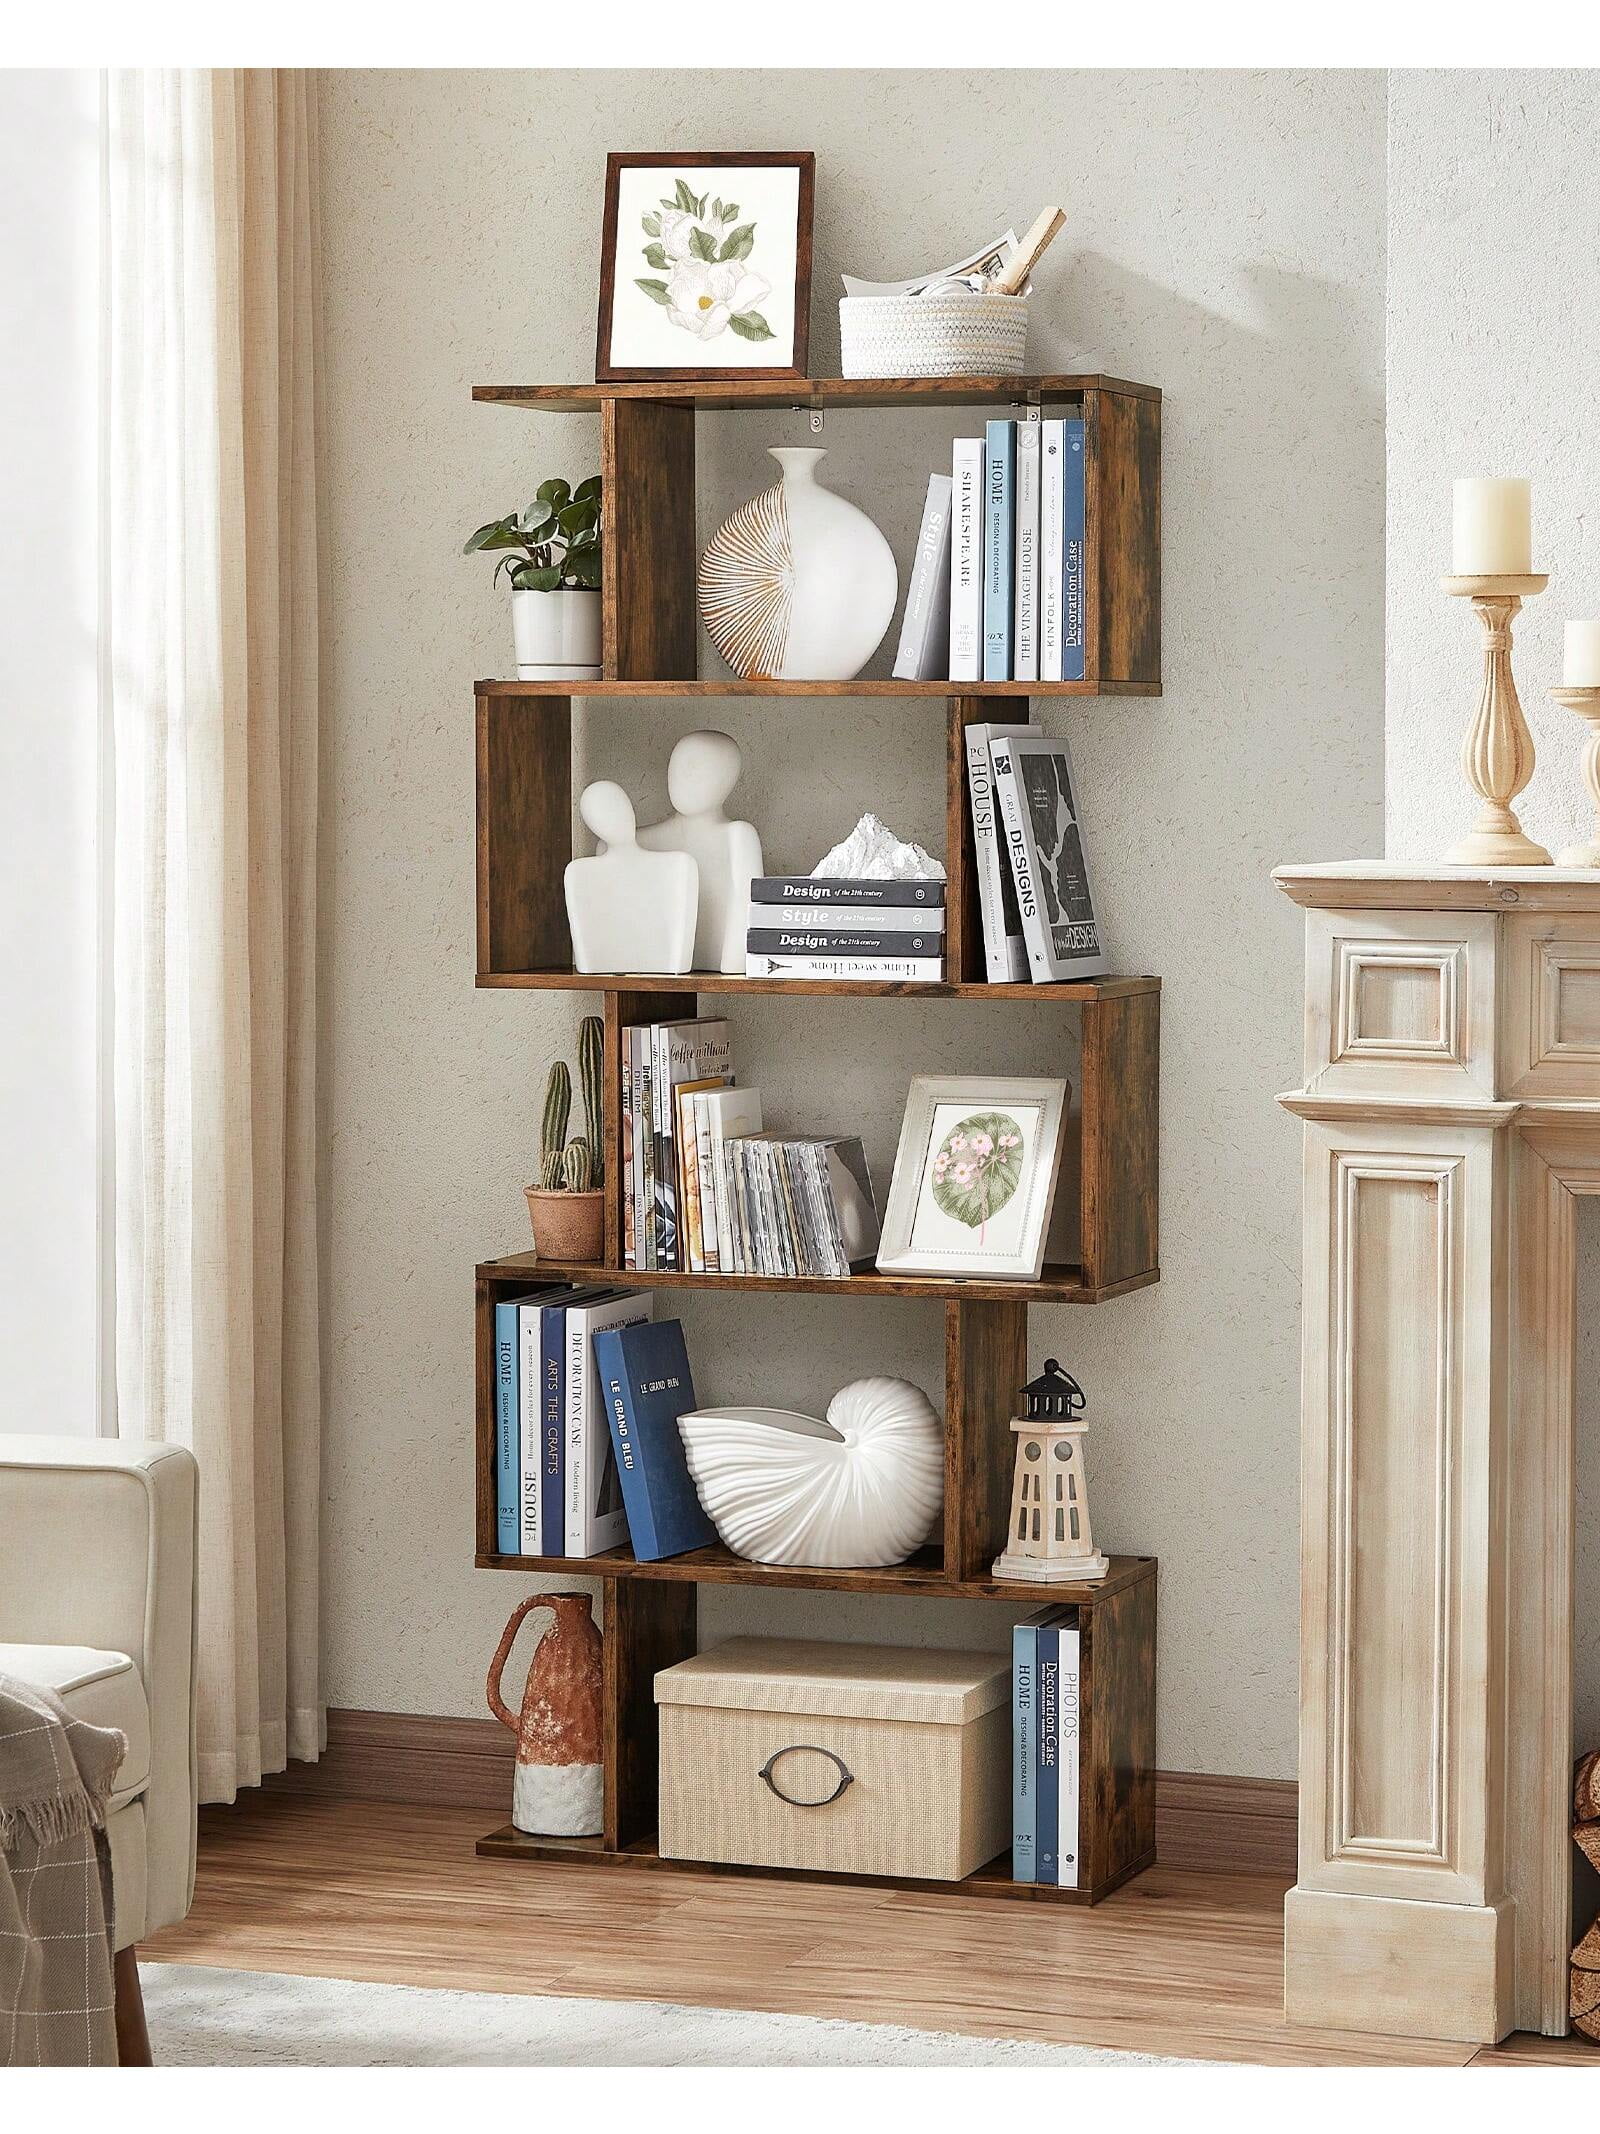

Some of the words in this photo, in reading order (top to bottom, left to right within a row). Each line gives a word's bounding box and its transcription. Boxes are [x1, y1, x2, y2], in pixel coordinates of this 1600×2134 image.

[991, 460, 1004, 505] HOME
[923, 511, 943, 561] Style
[961, 471, 972, 588] SHAKESPEARE
[1022, 528, 1032, 573] HOUSE
[1066, 540, 1078, 572] Case
[992, 548, 1000, 594] DECORATING
[1021, 575, 1031, 631] VINTAGE
[1047, 592, 1055, 647] KINFOLK
[1066, 575, 1078, 648] Decoration
[1021, 634, 1031, 661] THE
[970, 746, 985, 758] PC
[971, 763, 993, 839] HOUSE
[1006, 793, 1017, 823] GREAT
[1010, 830, 1036, 918] DESIGNS
[782, 885, 832, 900] Design
[834, 889, 842, 897] of
[841, 889, 850, 897] the
[863, 890, 884, 898] century
[782, 909, 829, 925] Style
[779, 934, 828, 949] Design
[831, 938, 840, 946] of
[839, 937, 849, 945] the
[860, 939, 881, 947] century
[808, 960, 844, 975] Home
[848, 961, 878, 971] sweet
[881, 963, 917, 976] Home
[500, 1341, 512, 1385] HOME
[548, 1358, 558, 1390] ARTS
[572, 1332, 583, 1415] DECORATION
[610, 1379, 620, 1393] LE
[640, 1383, 648, 1394] LE
[649, 1379, 666, 1392] GRAND
[547, 1396, 558, 1422] THE
[614, 1399, 628, 1437] GRAND
[571, 1417, 582, 1448] CASE
[547, 1427, 558, 1475] CRAFTS
[621, 1443, 634, 1470] BLEU
[524, 1471, 537, 1532] HOUSE
[572, 1492, 580, 1513] living
[1018, 1664, 1031, 1709] HOME
[1046, 1661, 1058, 1733] Decoration
[1063, 1672, 1078, 1738] PHOTOS
[1046, 1735, 1057, 1767] Case
